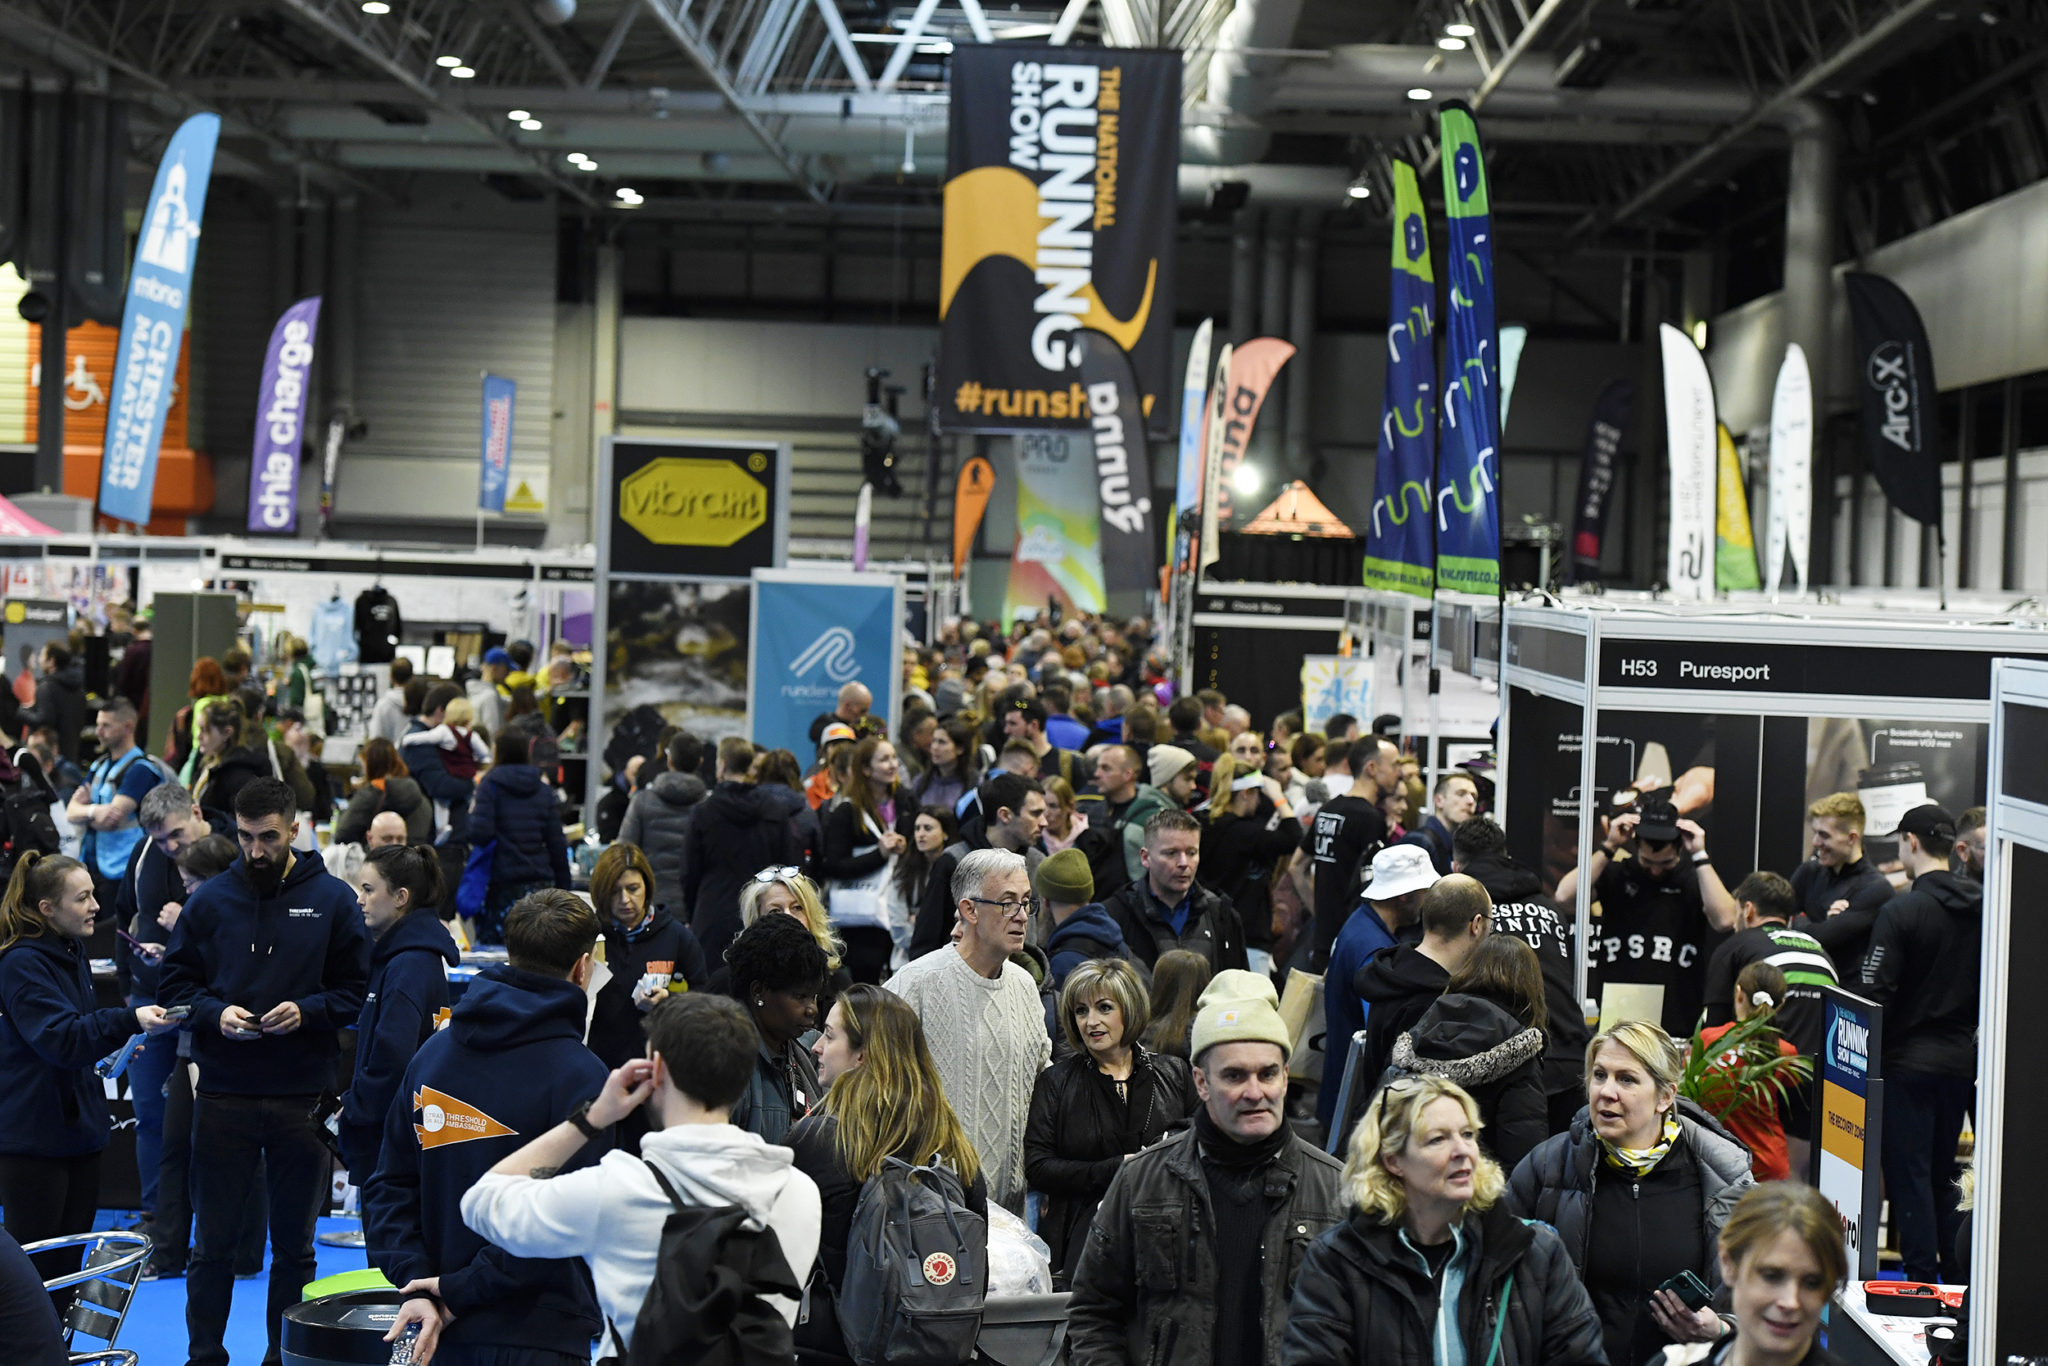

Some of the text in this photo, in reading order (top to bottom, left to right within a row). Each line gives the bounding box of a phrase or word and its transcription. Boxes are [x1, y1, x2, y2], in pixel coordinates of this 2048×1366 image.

[1009, 61, 1042, 169] SHOW
[1094, 114, 1119, 231] NATIONAL
[1031, 63, 1100, 371] RUNNING
[107, 313, 152, 488] MARATHON
[122, 320, 172, 490] CHESTER
[266, 320, 314, 446] charge
[258, 452, 294, 528] chia
[630, 480, 761, 520] vibram
[1621, 659, 1770, 682] H53 Puresport
[1603, 934, 1698, 969] PSRC
[446, 1112, 487, 1126] THRESHOLD
[446, 1121, 486, 1134] AMBASSADOR
[1835, 1114, 1854, 1136] RECOVERY
[1854, 1125, 1865, 1141] ZONE
